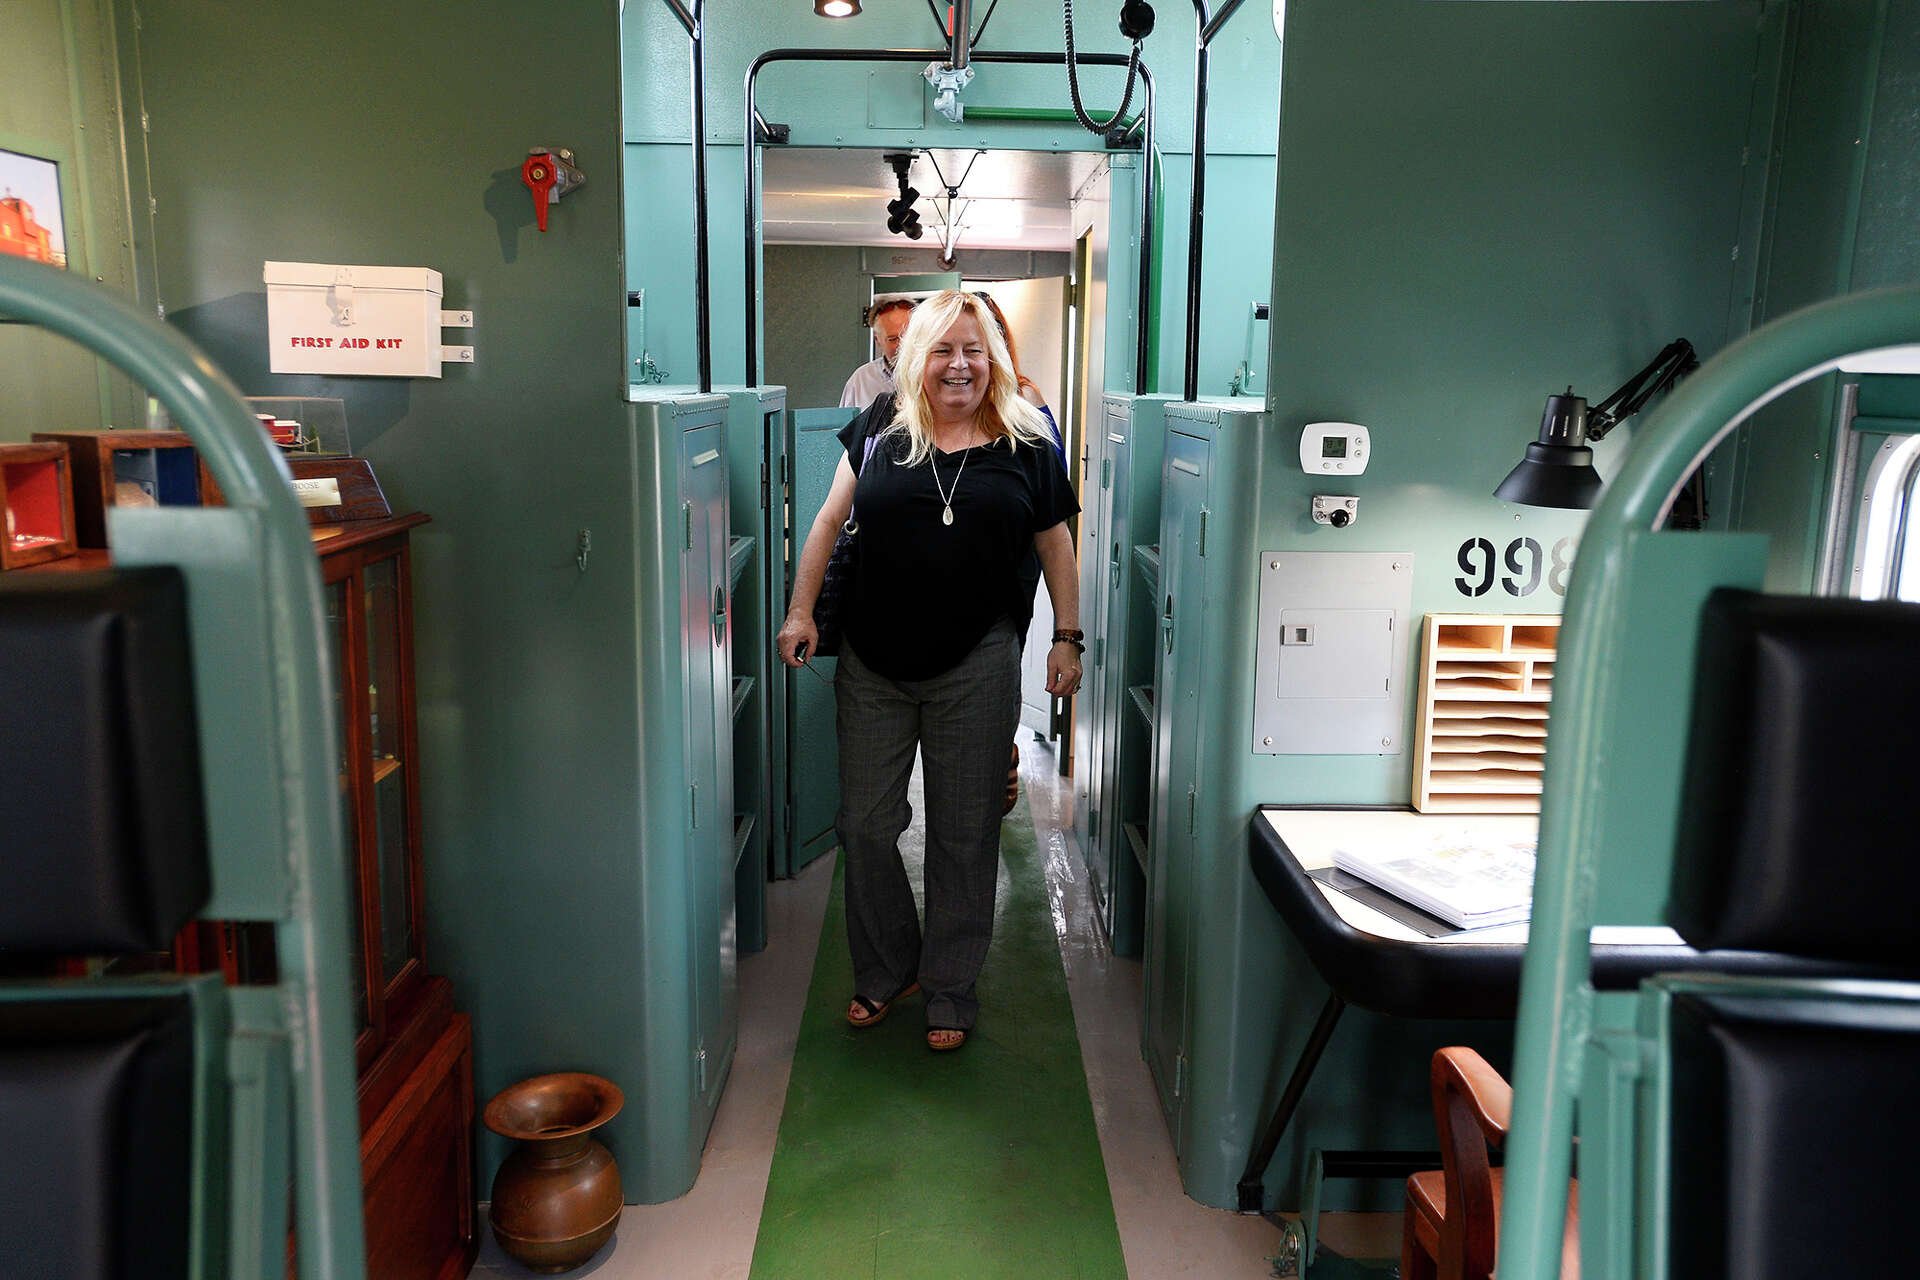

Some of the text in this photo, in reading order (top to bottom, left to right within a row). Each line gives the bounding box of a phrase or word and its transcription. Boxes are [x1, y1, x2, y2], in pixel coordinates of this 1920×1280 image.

[291, 337, 403, 349] FIRST AID KIT
[289, 481, 321, 490] BOOSE
